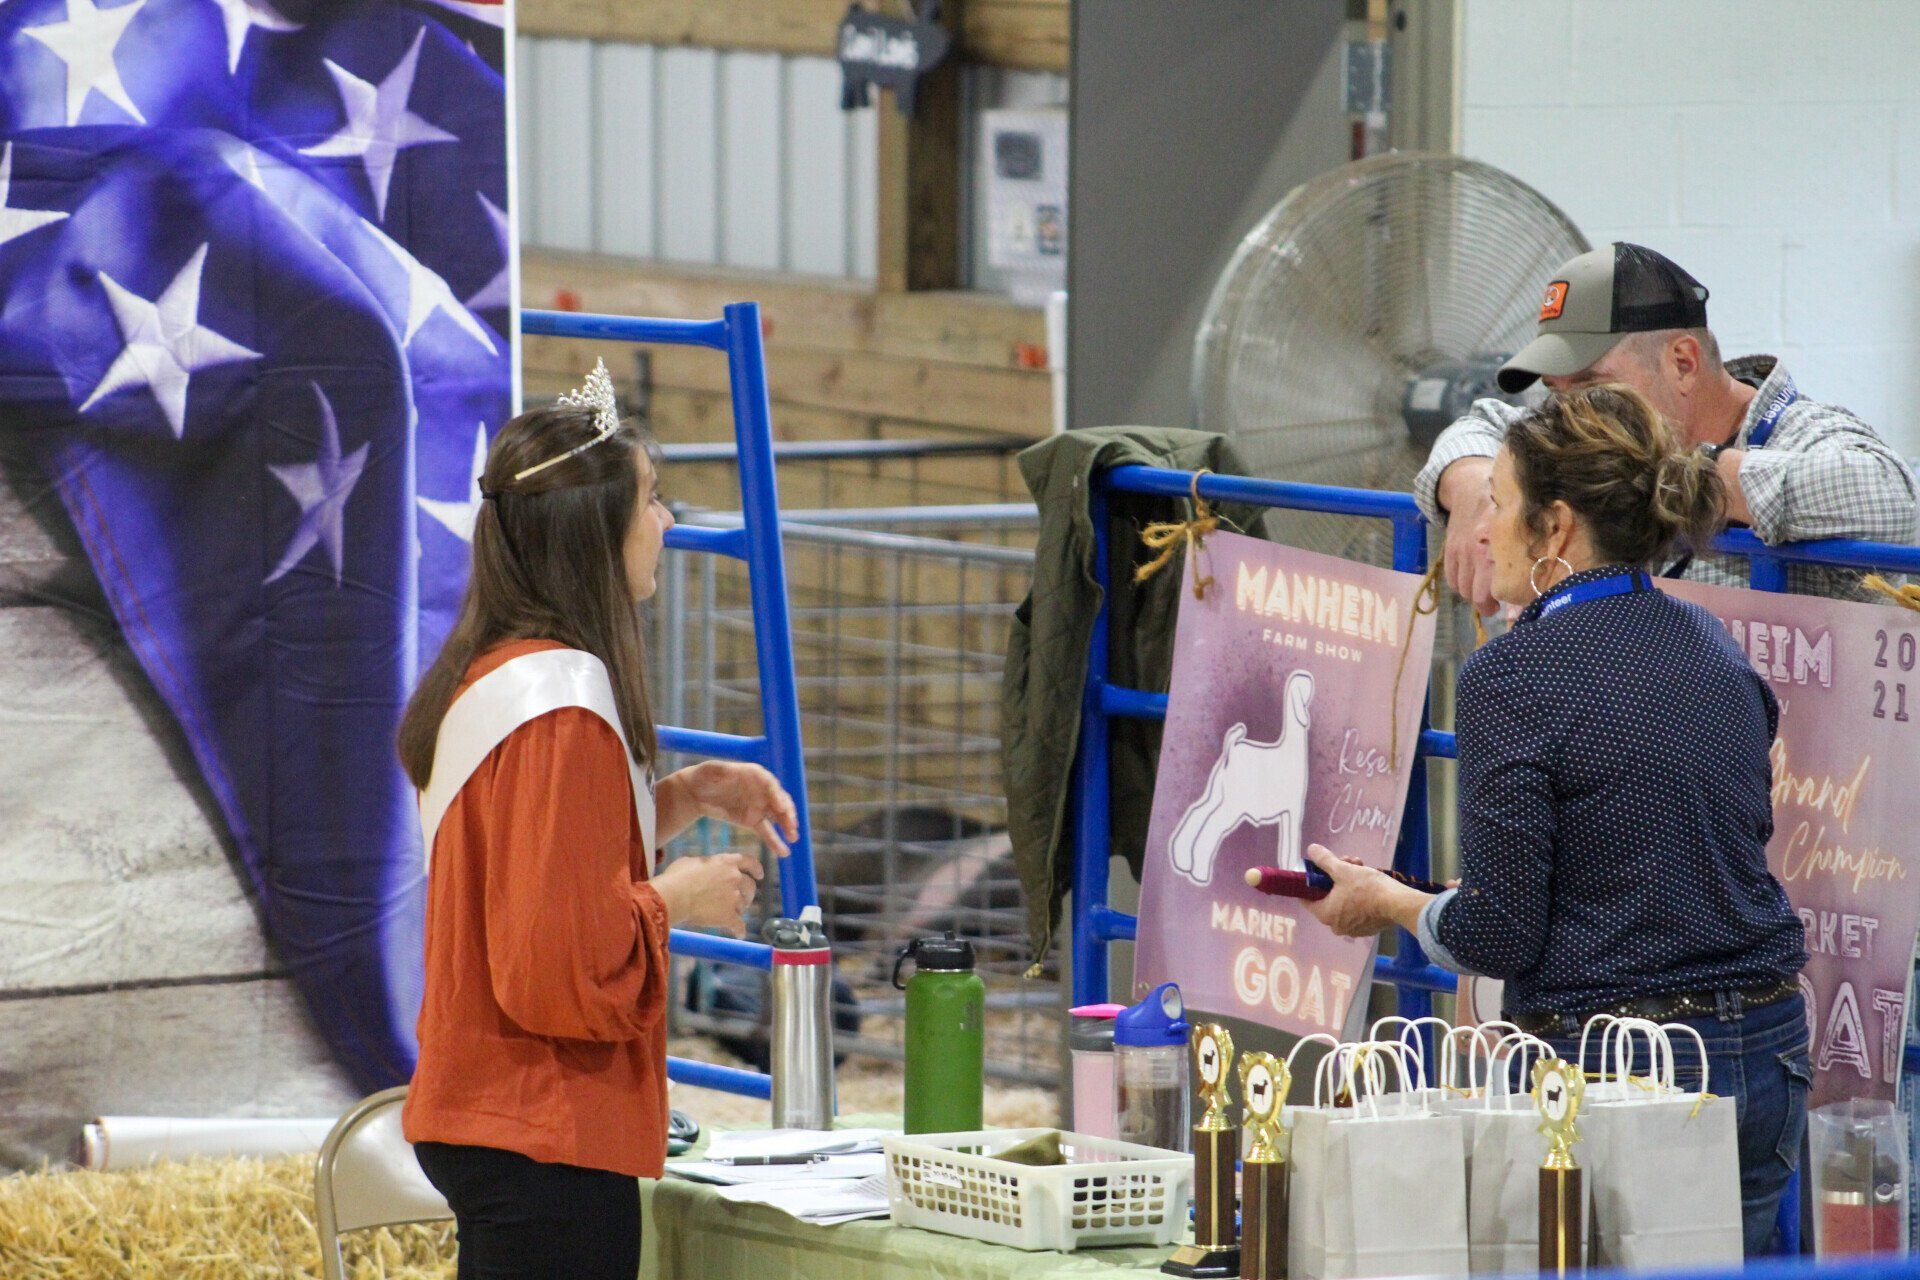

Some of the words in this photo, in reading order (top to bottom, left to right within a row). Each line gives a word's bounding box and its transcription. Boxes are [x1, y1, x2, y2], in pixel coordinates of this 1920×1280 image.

[1236, 560, 1398, 647] MANHEIM
[1263, 629, 1307, 650] FARM
[1315, 643, 1363, 663] SHOW
[1875, 629, 1916, 671] 20
[1873, 680, 1909, 722] 21
[1783, 821, 1906, 894] Champion
[1211, 901, 1296, 944] MARKET
[1798, 907, 1879, 960] RKET
[1234, 946, 1351, 1031] GOAT
